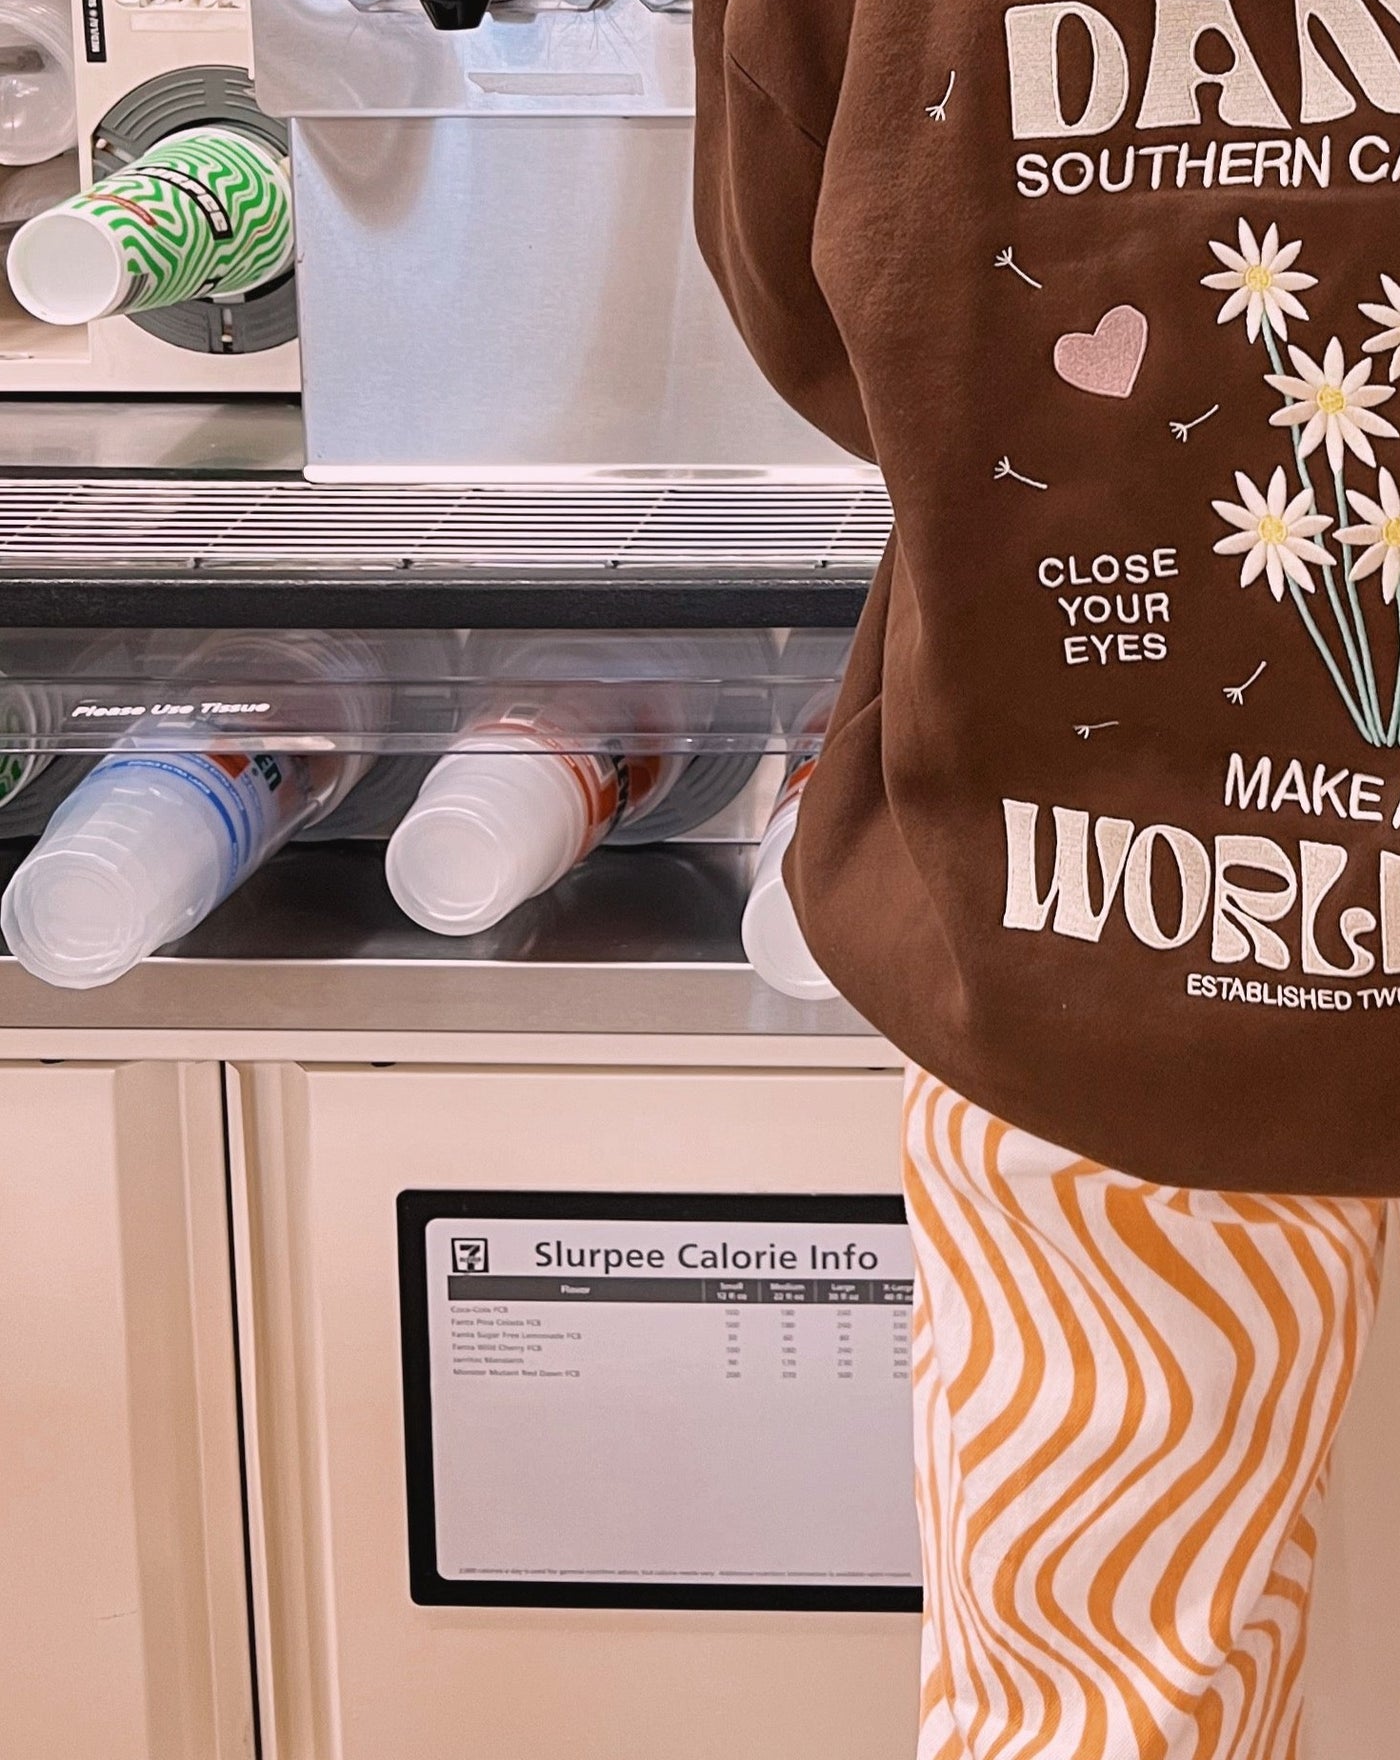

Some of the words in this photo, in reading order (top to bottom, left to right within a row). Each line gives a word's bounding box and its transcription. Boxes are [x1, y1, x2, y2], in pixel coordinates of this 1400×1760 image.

[1014, 134, 1332, 199] SOUTHERN
[1037, 547, 1180, 588] CLOSE
[1056, 592, 1172, 627] YOUR
[1063, 632, 1169, 665] EYES
[72, 706, 146, 717] Please
[151, 704, 194, 715] Use
[201, 703, 271, 714] Tissue
[1223, 752, 1386, 824] MAKE
[1186, 972, 1352, 1011] ESTABLISHED
[535, 1240, 665, 1275] Slurpee
[677, 1242, 798, 1270] Calorie
[811, 1243, 878, 1270] Info
